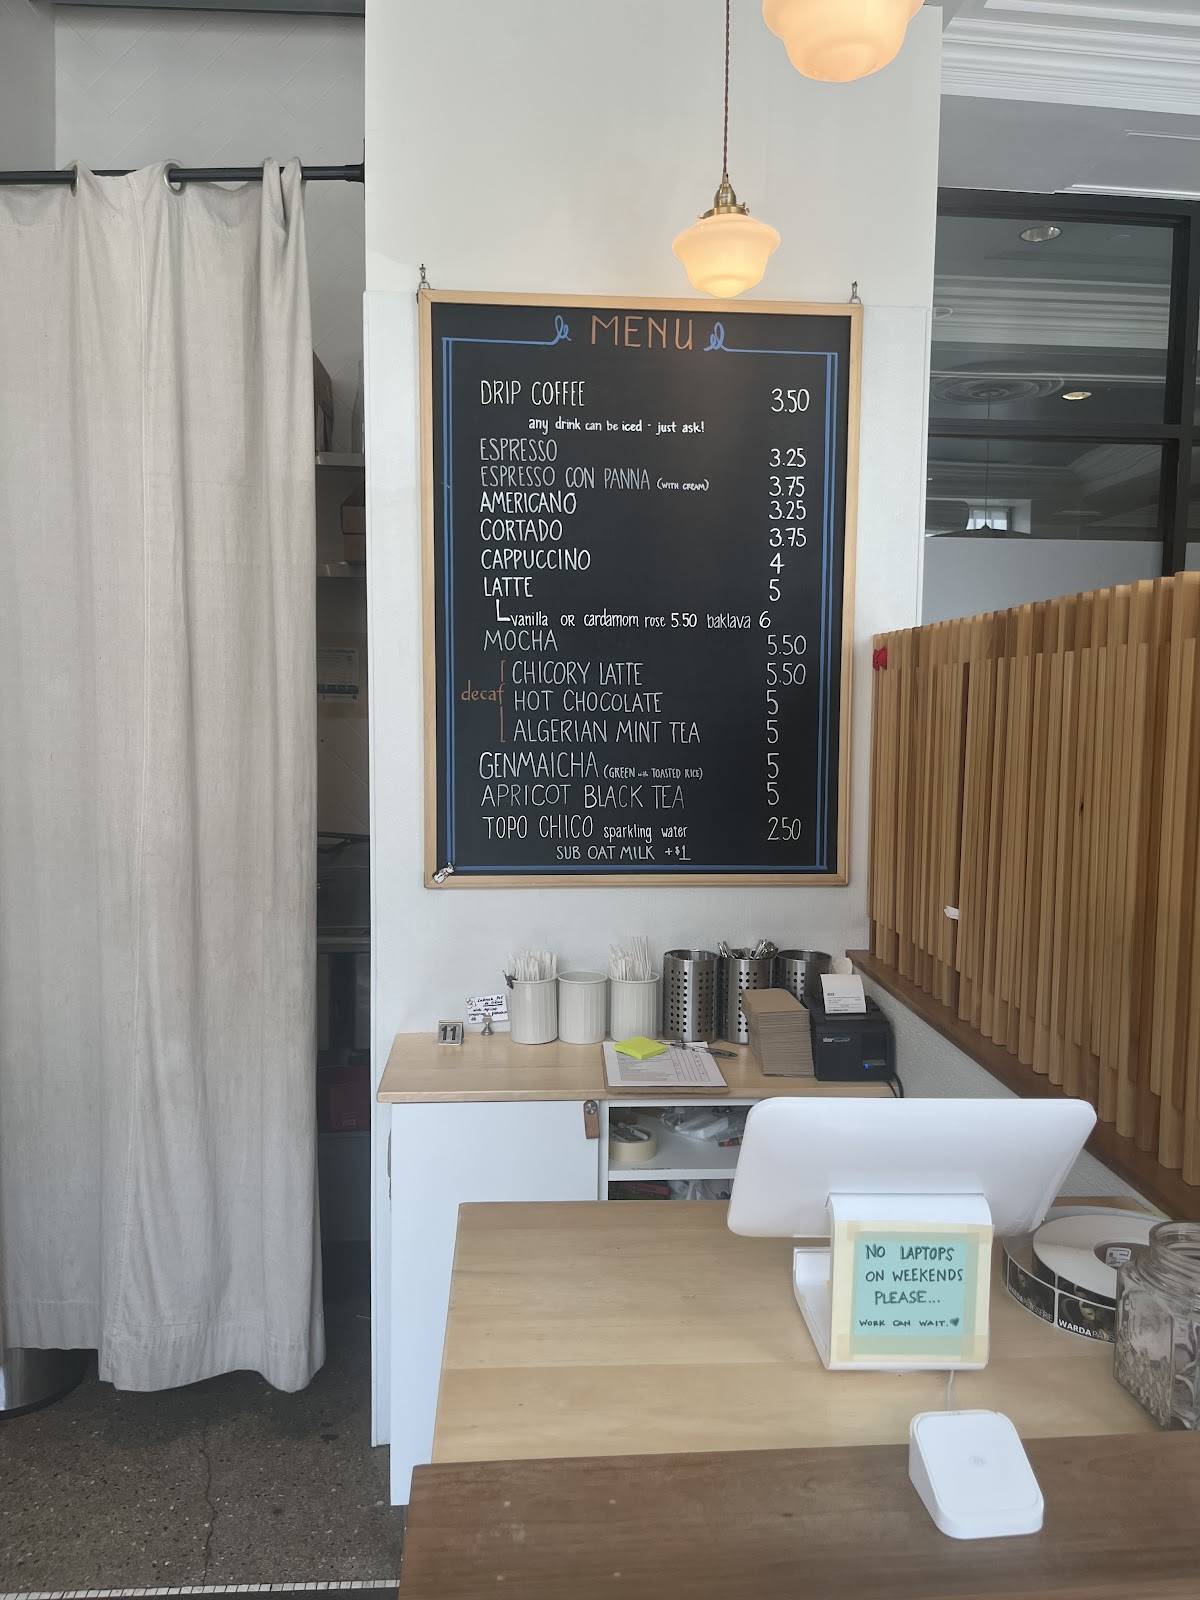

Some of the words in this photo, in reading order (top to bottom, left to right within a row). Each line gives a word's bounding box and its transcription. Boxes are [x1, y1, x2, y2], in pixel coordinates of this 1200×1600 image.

[591, 315, 694, 351] MENU
[481, 380, 521, 404] DRIP
[532, 381, 585, 406] COFFEE
[771, 388, 809, 413] 3.50
[529, 419, 548, 435] any
[555, 416, 581, 430] drink
[585, 422, 602, 431] can
[606, 420, 618, 430] be
[622, 419, 642, 432] iced
[656, 421, 677, 435] just
[682, 421, 704, 433] ask!
[481, 438, 557, 461] ESPRESSO
[769, 448, 806, 467] 3.25
[481, 465, 555, 487] ESPRESSO
[566, 467, 594, 488] CON
[605, 468, 650, 490] PANNA
[657, 478, 679, 489] (WITH
[682, 479, 709, 491] CREAM)
[769, 476, 805, 497] 3.75
[480, 490, 576, 514] AMERICANO
[769, 500, 806, 520] 3.25
[481, 518, 562, 542] CORTADO
[770, 528, 806, 547] 3.75
[481, 548, 590, 570] CAPPUCCINO
[770, 553, 785, 574] 4
[484, 577, 533, 597] LATTE
[770, 579, 780, 601] 5
[511, 611, 548, 626] vanilla
[561, 615, 575, 626] OR
[584, 608, 639, 627] cardamom
[645, 617, 666, 628] rose
[671, 613, 697, 627] 5.50
[707, 612, 751, 628] baklava
[759, 611, 771, 628] 6
[484, 630, 557, 651] MOCHA
[768, 635, 806, 655] 5.50
[513, 661, 590, 684] CHICORY
[600, 662, 643, 685] LATTE
[767, 663, 806, 685] 5.50
[461, 680, 505, 704] decaf
[515, 691, 553, 711] HOT
[563, 690, 663, 712] CHOCOLATE
[767, 690, 778, 714] 5
[514, 719, 607, 742] ALGERIAN
[616, 720, 661, 743] MINT
[669, 722, 700, 743] TEA
[767, 720, 778, 743] 5
[480, 752, 598, 779] GENMAICHA
[604, 764, 635, 780] (GREEN
[651, 768, 681, 779] TOASTED
[685, 768, 703, 780] RICE)
[768, 753, 779, 778] 5
[481, 784, 571, 807] APRICOT
[585, 785, 643, 808] BLACK
[651, 785, 684, 809] TEA
[767, 782, 779, 805] 5
[482, 816, 527, 839] TOPO
[539, 814, 593, 838] CHICO
[604, 824, 652, 843] sparkling
[661, 826, 688, 837] water
[557, 846, 580, 859] SUB
[588, 846, 616, 860] OAT
[620, 846, 655, 860] MILK
[441, 1026, 456, 1040] 11
[866, 1244, 886, 1260] NO
[900, 1246, 956, 1262] LAPTOPS
[866, 1270, 884, 1282] ON
[892, 1268, 963, 1282] WEEKENDS
[874, 1291, 941, 1305] PLEASE...
[858, 1319, 887, 1328] WORK
[892, 1319, 911, 1327] CAN
[1058, 1319, 1092, 1337] WARDA
